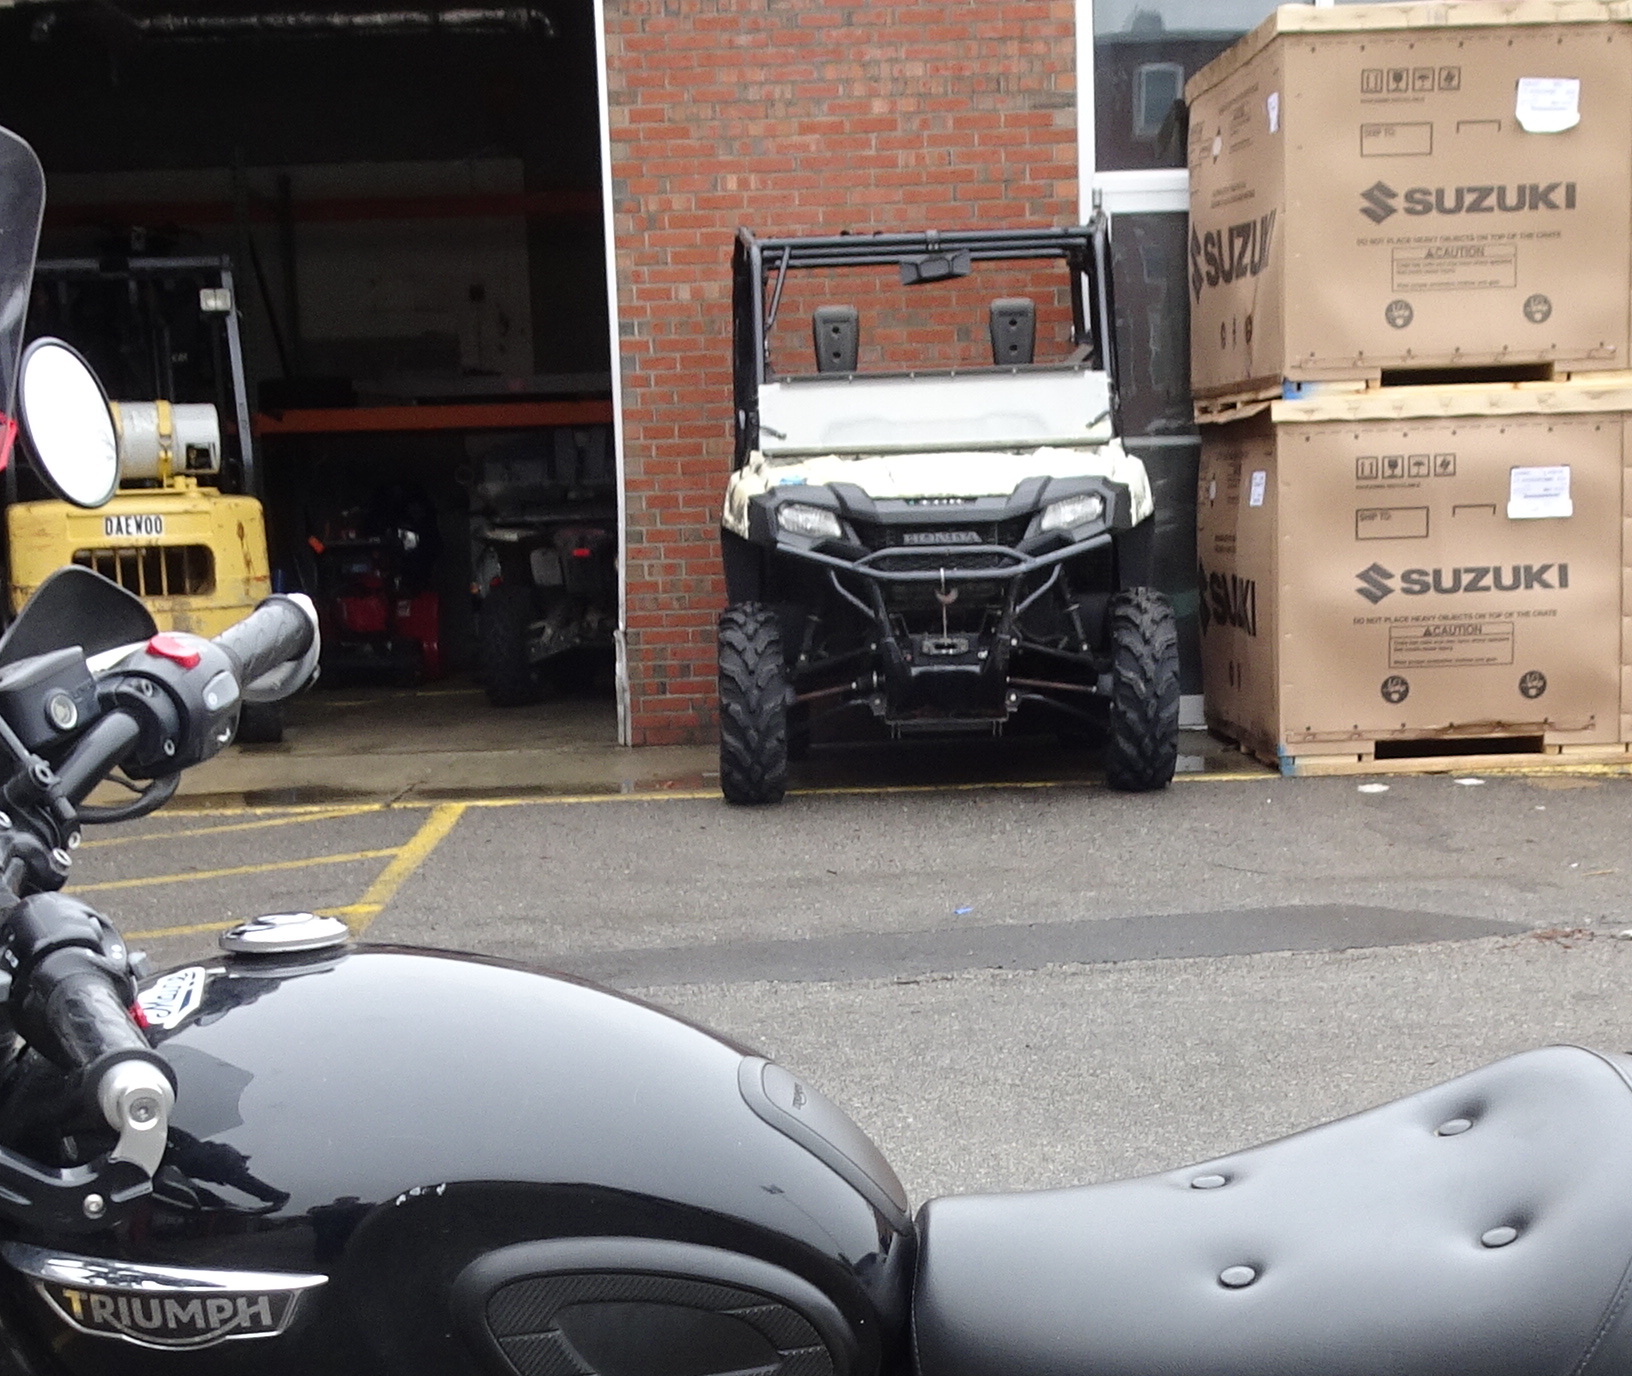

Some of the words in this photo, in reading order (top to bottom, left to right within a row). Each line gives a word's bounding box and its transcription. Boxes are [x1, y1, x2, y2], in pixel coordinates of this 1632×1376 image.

[1403, 182, 1577, 216] SUZUKI
[1434, 246, 1485, 258] CAUTION
[104, 514, 164, 536] DAEWOO
[902, 530, 983, 545] HONDA
[1400, 563, 1569, 596] SUZUKI
[1434, 624, 1483, 636] CAUTION
[62, 1288, 275, 1331] TRIUMPH
